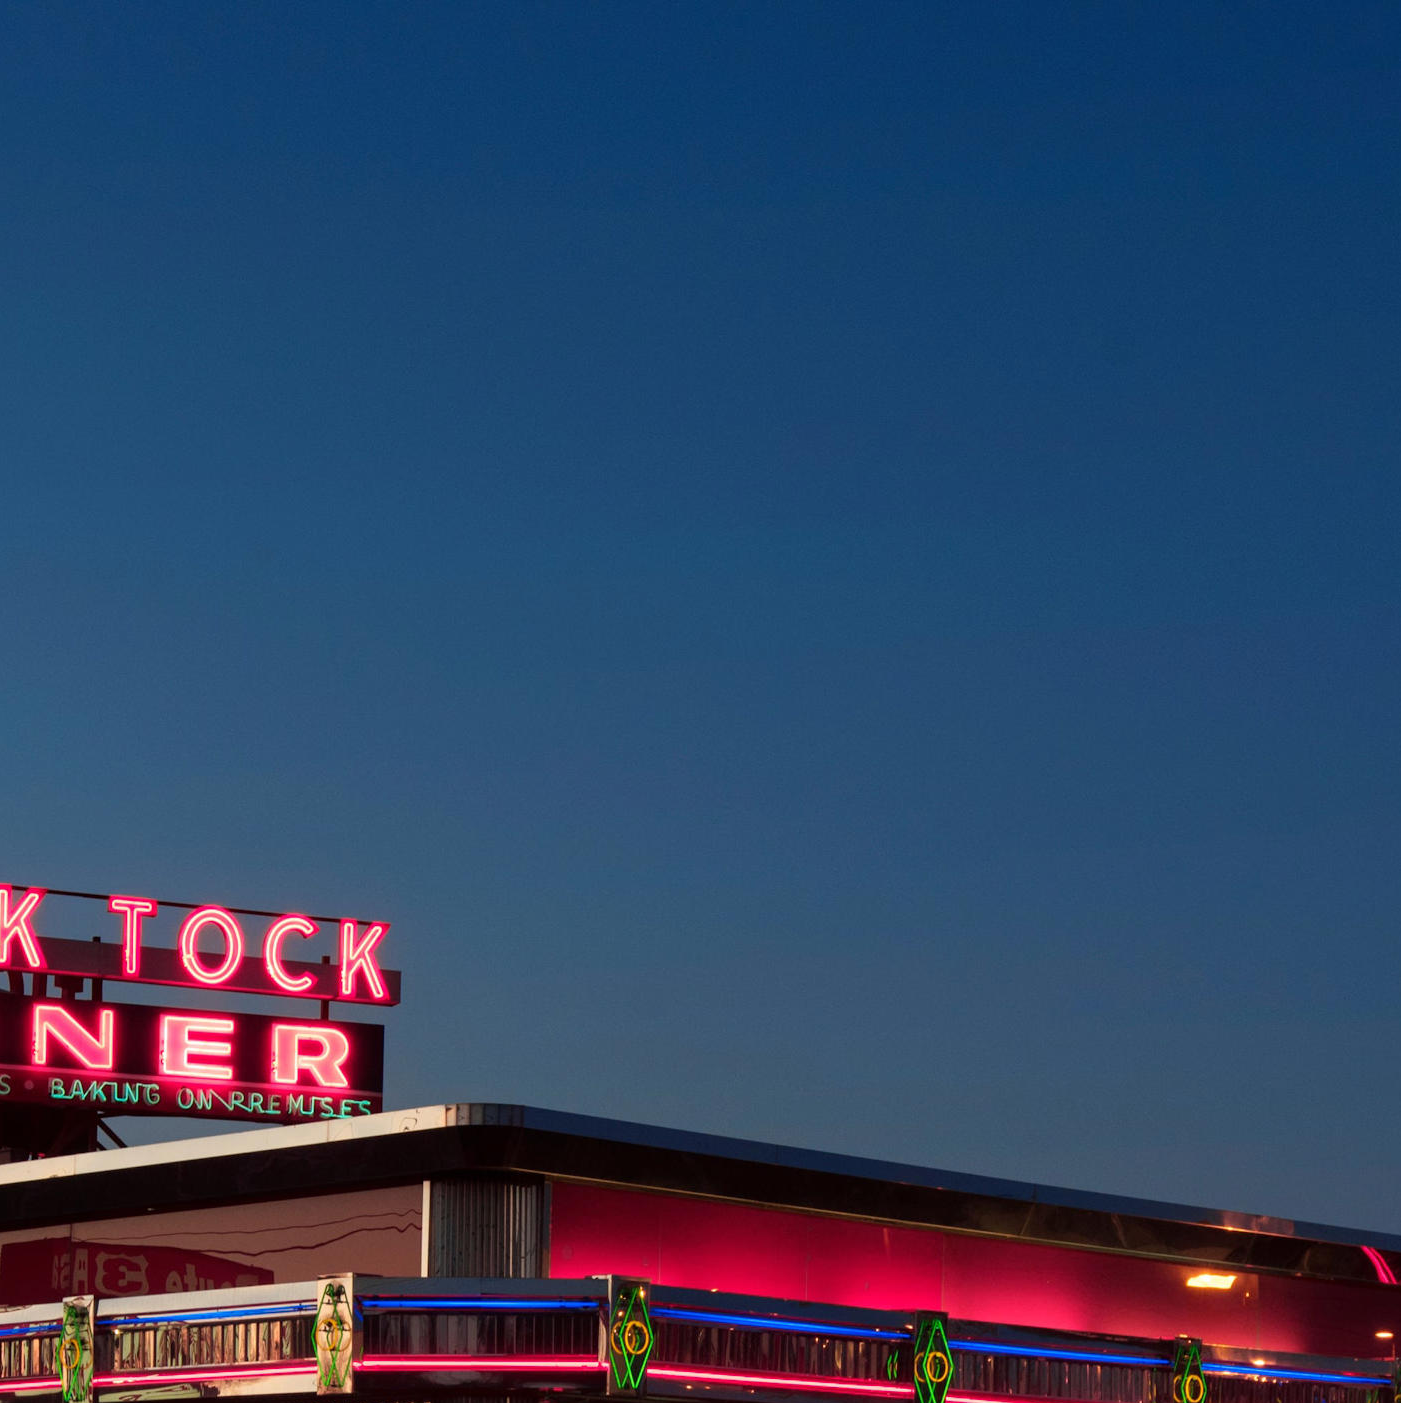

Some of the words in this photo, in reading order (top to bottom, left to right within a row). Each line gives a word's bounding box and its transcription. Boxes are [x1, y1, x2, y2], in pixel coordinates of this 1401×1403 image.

[107, 894, 391, 1000] TOCK
[50, 1078, 161, 1104] BAKING
[176, 1086, 213, 1110] ON
